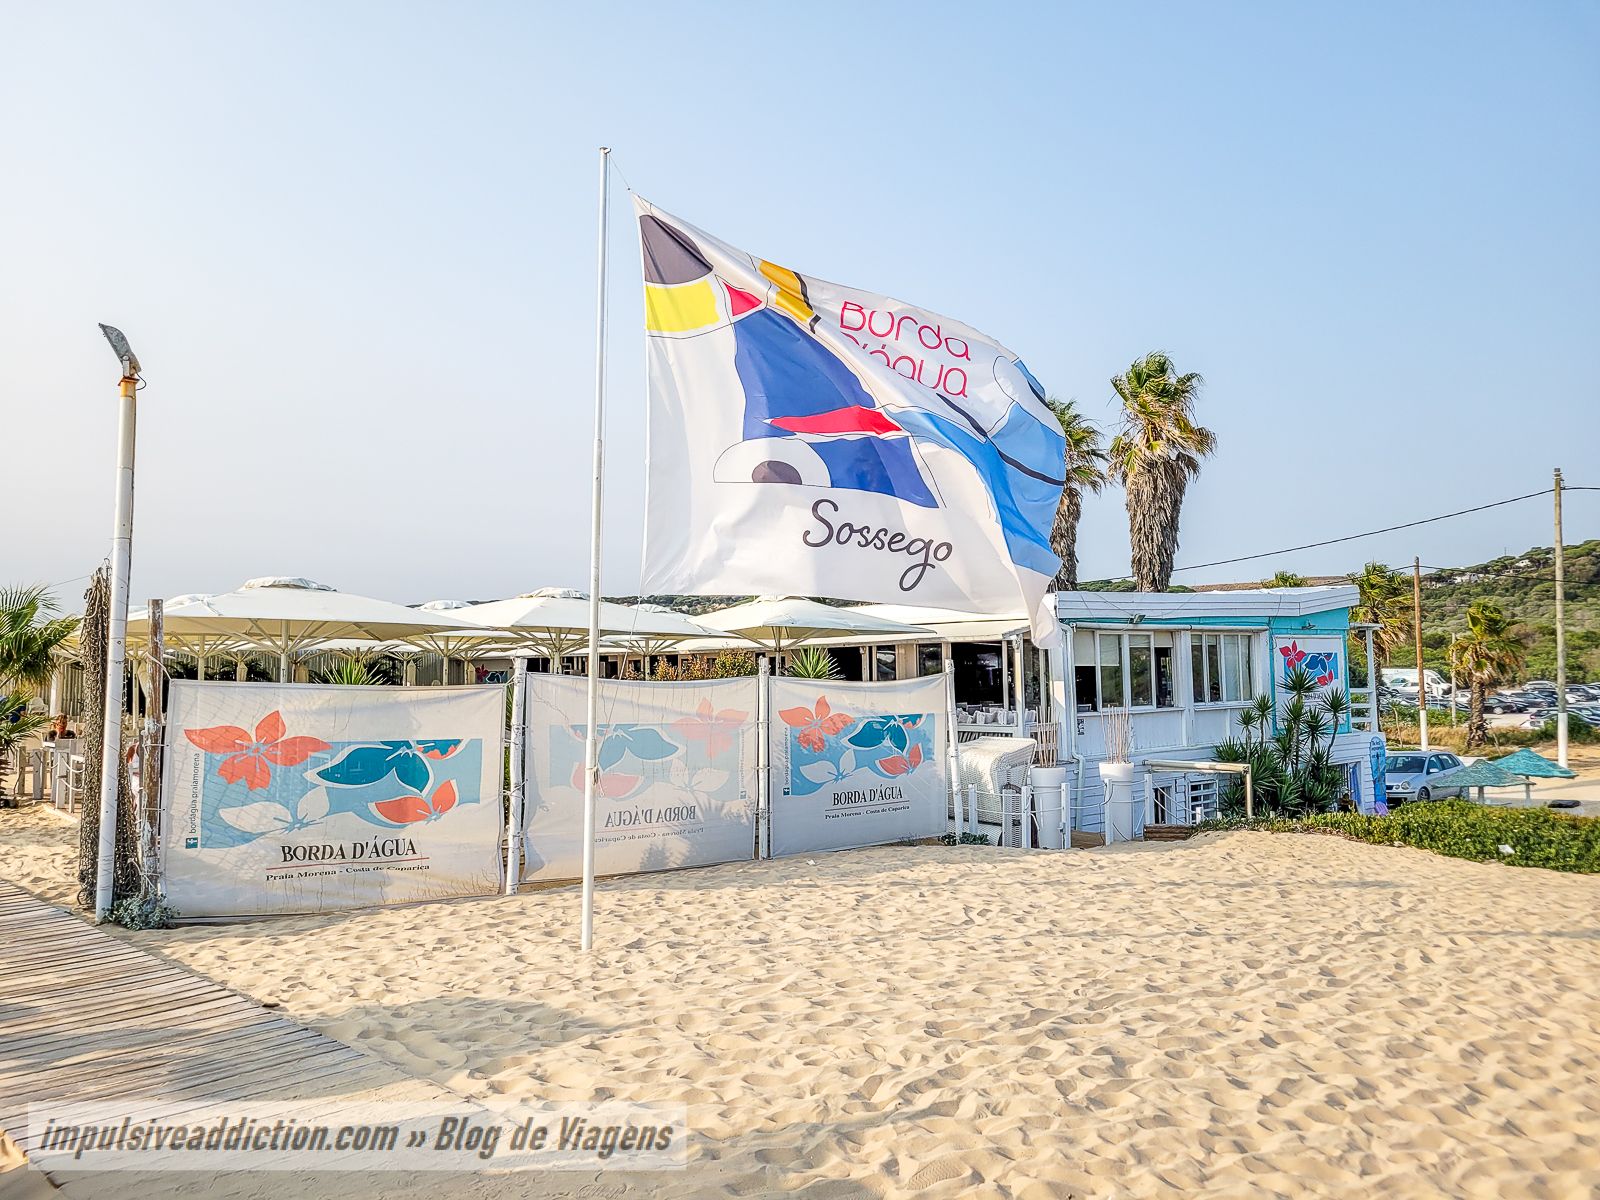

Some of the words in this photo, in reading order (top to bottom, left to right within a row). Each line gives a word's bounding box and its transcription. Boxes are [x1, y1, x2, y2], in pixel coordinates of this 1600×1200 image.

[840, 301, 971, 362] Borda
[803, 498, 953, 592] Sossego
[832, 789, 867, 806] BORDA
[869, 783, 903, 802] D'ÁGUA
[280, 843, 346, 862] BORDA
[351, 835, 417, 860] D'ÁGUA
[266, 873, 294, 881] Praia
[297, 869, 337, 879] Morena
[345, 866, 371, 874] Costa
